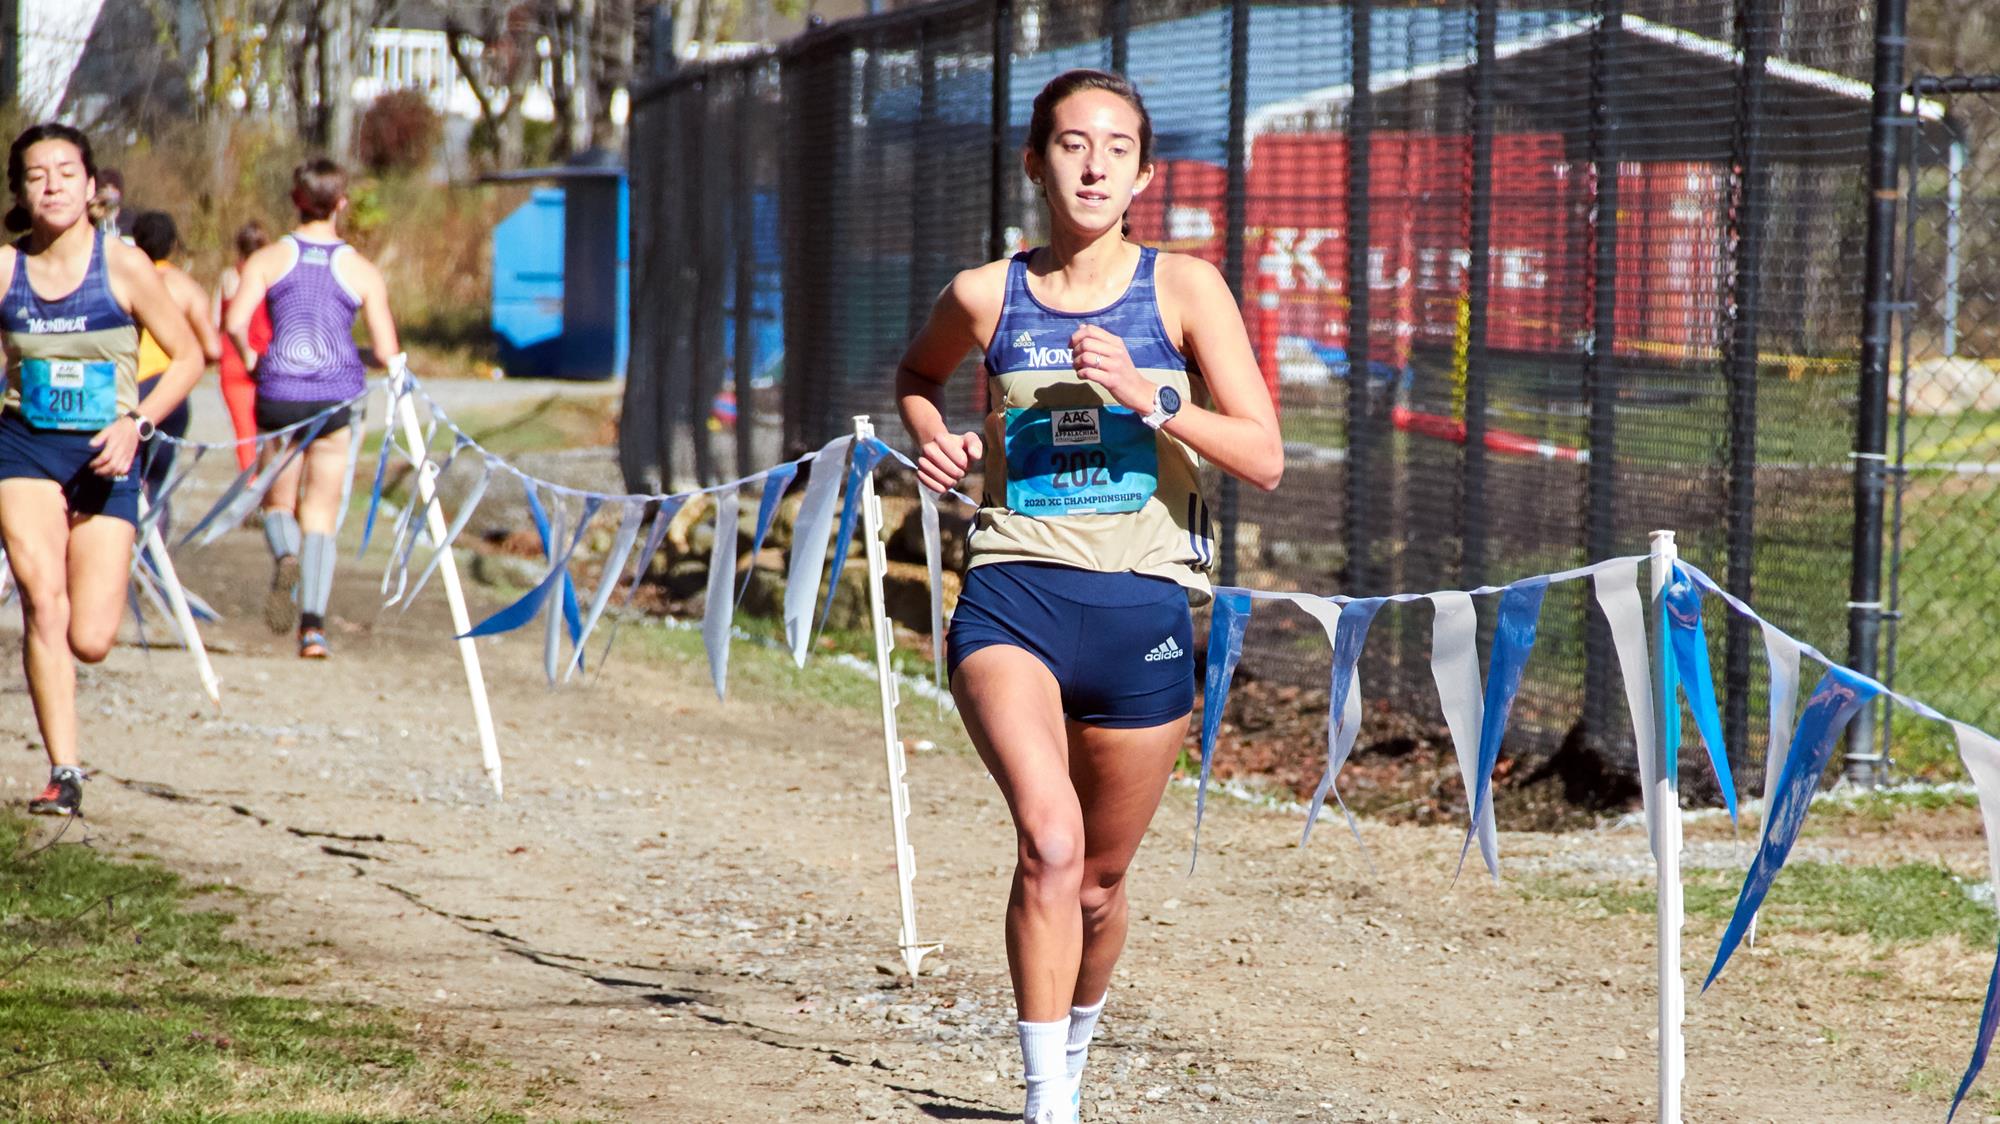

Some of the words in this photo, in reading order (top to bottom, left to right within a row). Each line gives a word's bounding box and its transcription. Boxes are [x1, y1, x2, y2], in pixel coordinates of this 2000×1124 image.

[1023, 346, 1074, 369] MON
[49, 389, 83, 413] 201
[1062, 410, 1090, 424] AAC
[1051, 450, 1108, 489] 202
[1024, 498, 1046, 507] 2020
[1048, 497, 1062, 506] XC
[1064, 492, 1142, 506] CHAMPIONSHIPS
[1144, 649, 1184, 661] adidas
